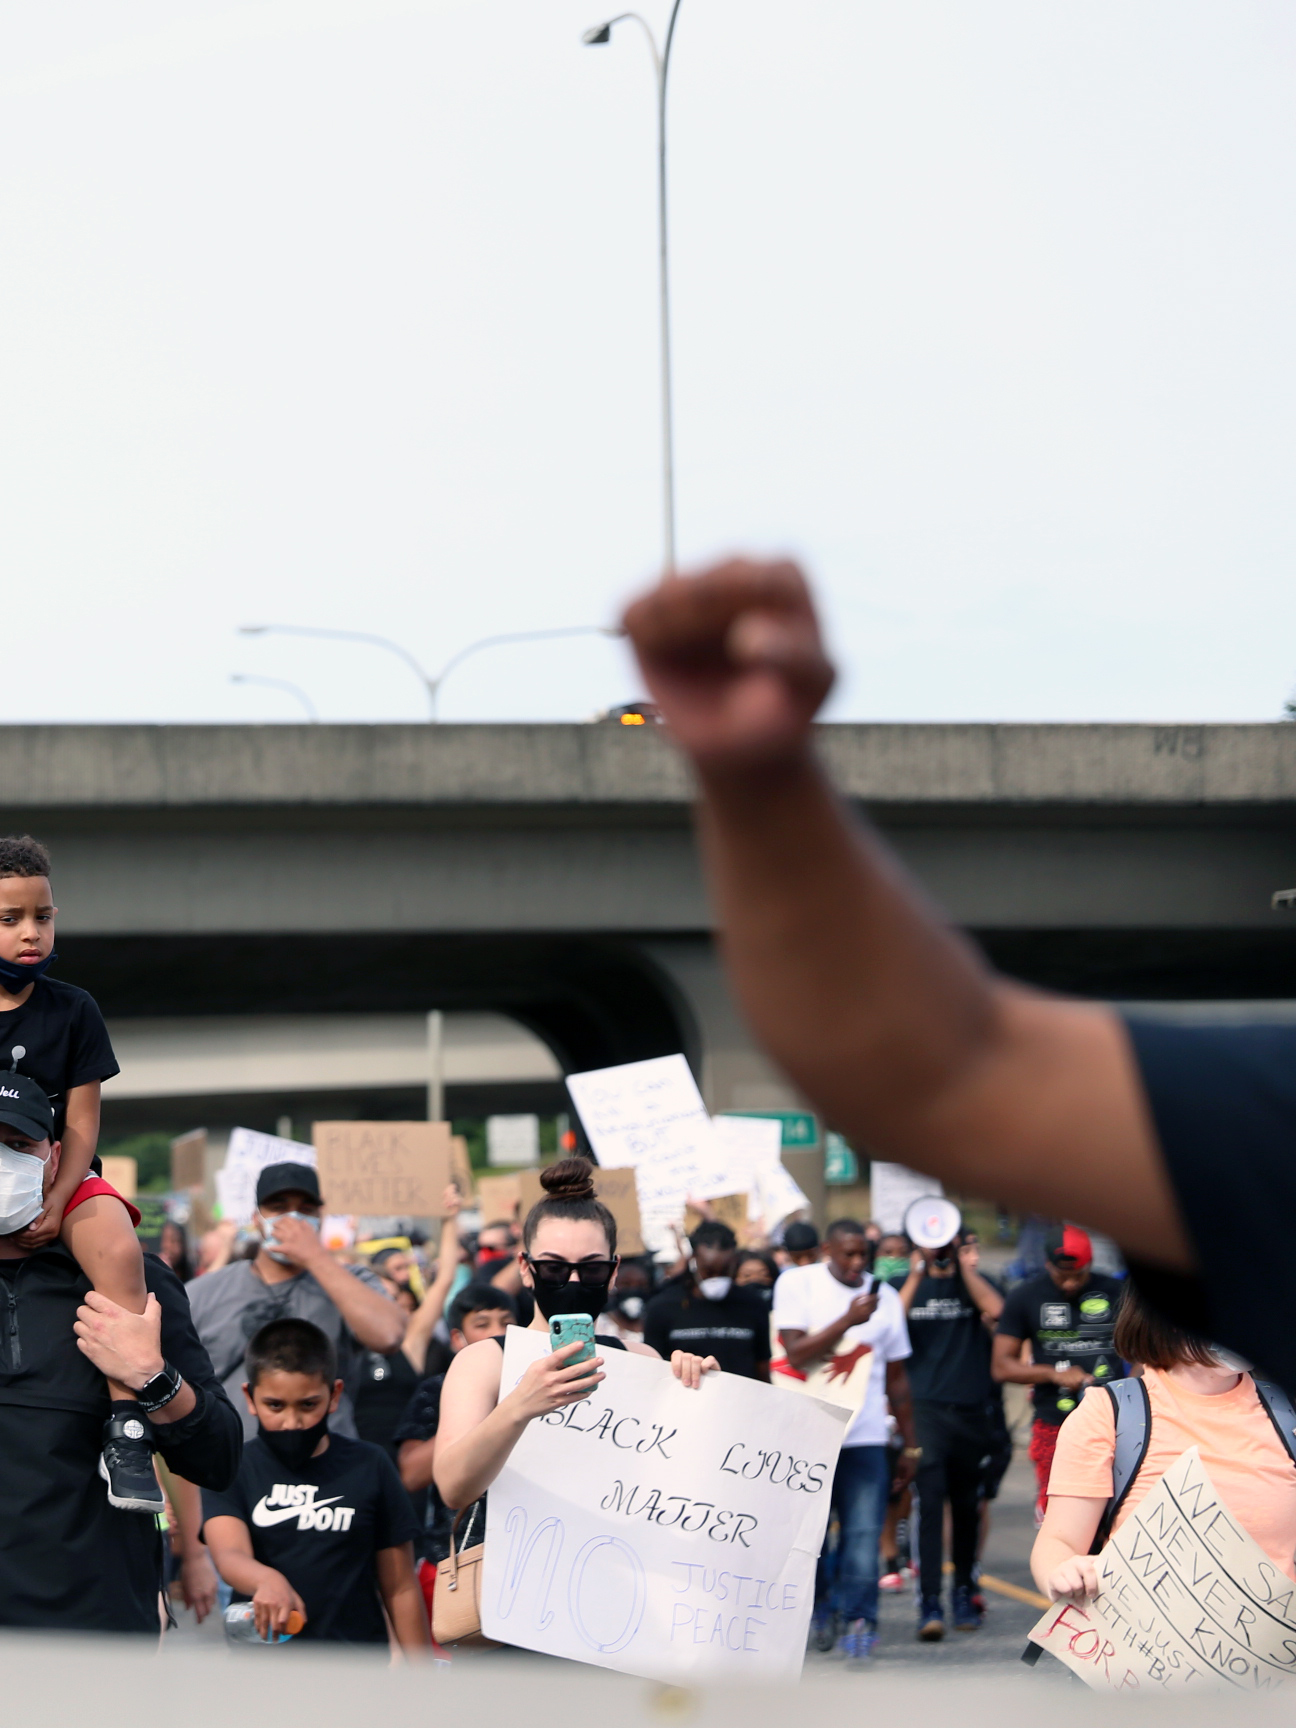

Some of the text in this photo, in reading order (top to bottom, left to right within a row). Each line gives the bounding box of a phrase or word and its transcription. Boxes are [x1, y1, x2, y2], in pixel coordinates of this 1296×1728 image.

[325, 1129, 412, 1155] BLACK
[326, 1150, 404, 1175] LIVES
[325, 1177, 429, 1207] MATTER
[540, 1400, 828, 1493] BLACK LIVES
[266, 1483, 320, 1508] JUST
[600, 1479, 759, 1548] MATTER
[1179, 1459, 1296, 1627] WE SA
[671, 1560, 799, 1611] JUSTICE
[1129, 1530, 1286, 1690] WE KNOW
[1146, 1501, 1296, 1669] NEVER S
[670, 1602, 768, 1652] PEACE
[1041, 1603, 1116, 1684] FOR
[1102, 1557, 1139, 1612] WE
[1138, 1617, 1204, 1683] JUST
